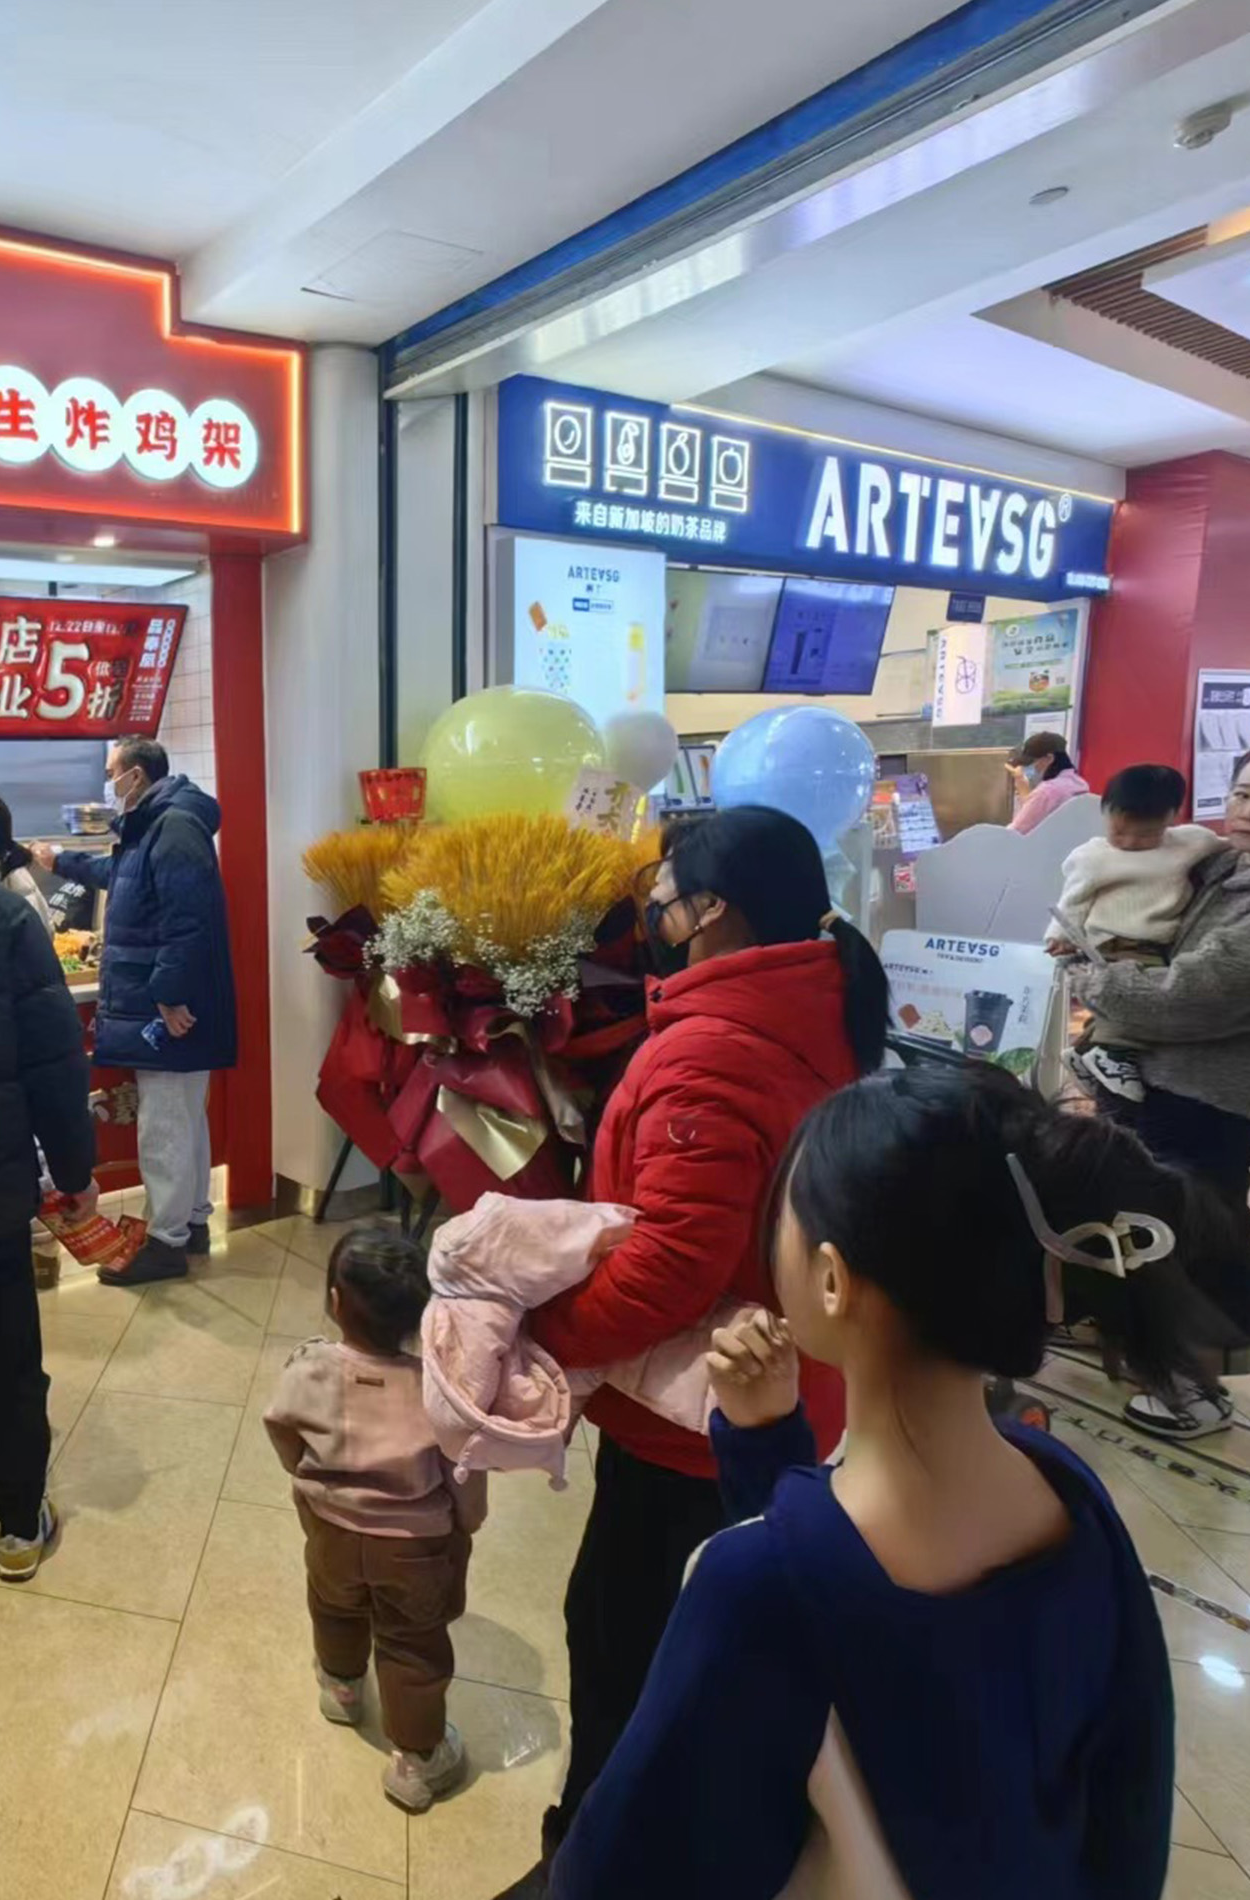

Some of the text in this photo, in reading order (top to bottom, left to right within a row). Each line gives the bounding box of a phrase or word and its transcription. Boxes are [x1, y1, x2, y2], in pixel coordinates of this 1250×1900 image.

[574, 500, 727, 544] 来自新加坡的奶茶品牌
